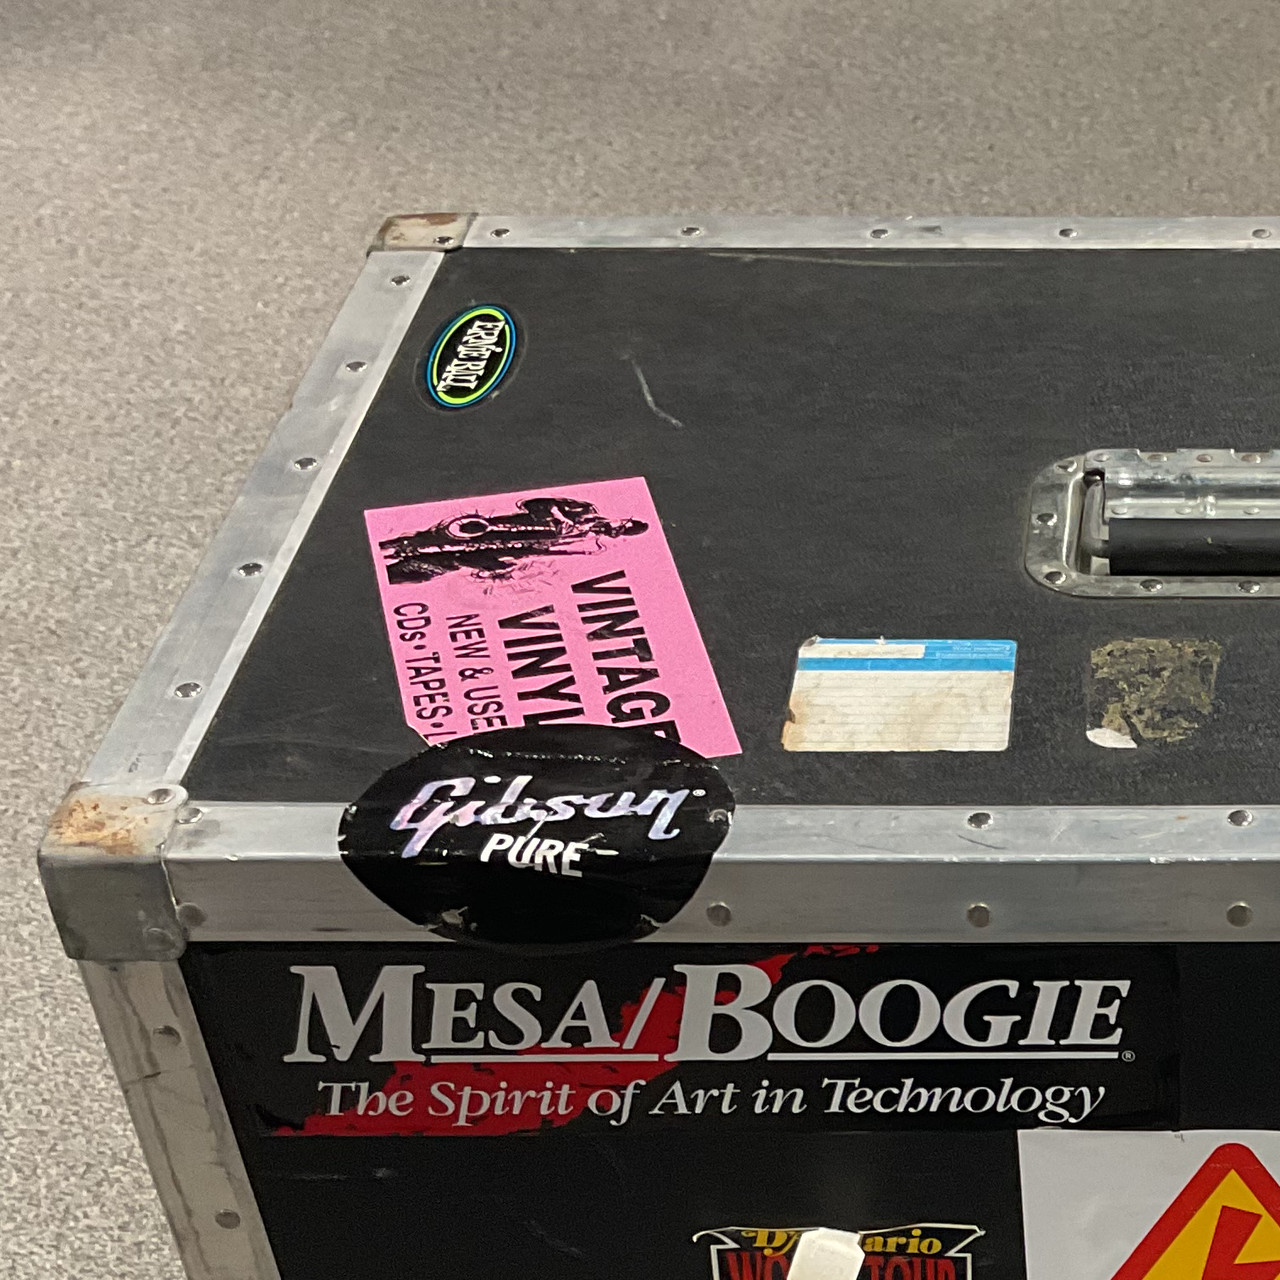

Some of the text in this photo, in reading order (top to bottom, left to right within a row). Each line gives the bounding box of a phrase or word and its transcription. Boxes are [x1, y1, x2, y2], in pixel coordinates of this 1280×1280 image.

[446, 613, 508, 730] NEW & USE
[498, 603, 586, 728] VINYL
[480, 832, 588, 878] PURE
[317, 1077, 1106, 1127] The Spirit of Art in Technology
